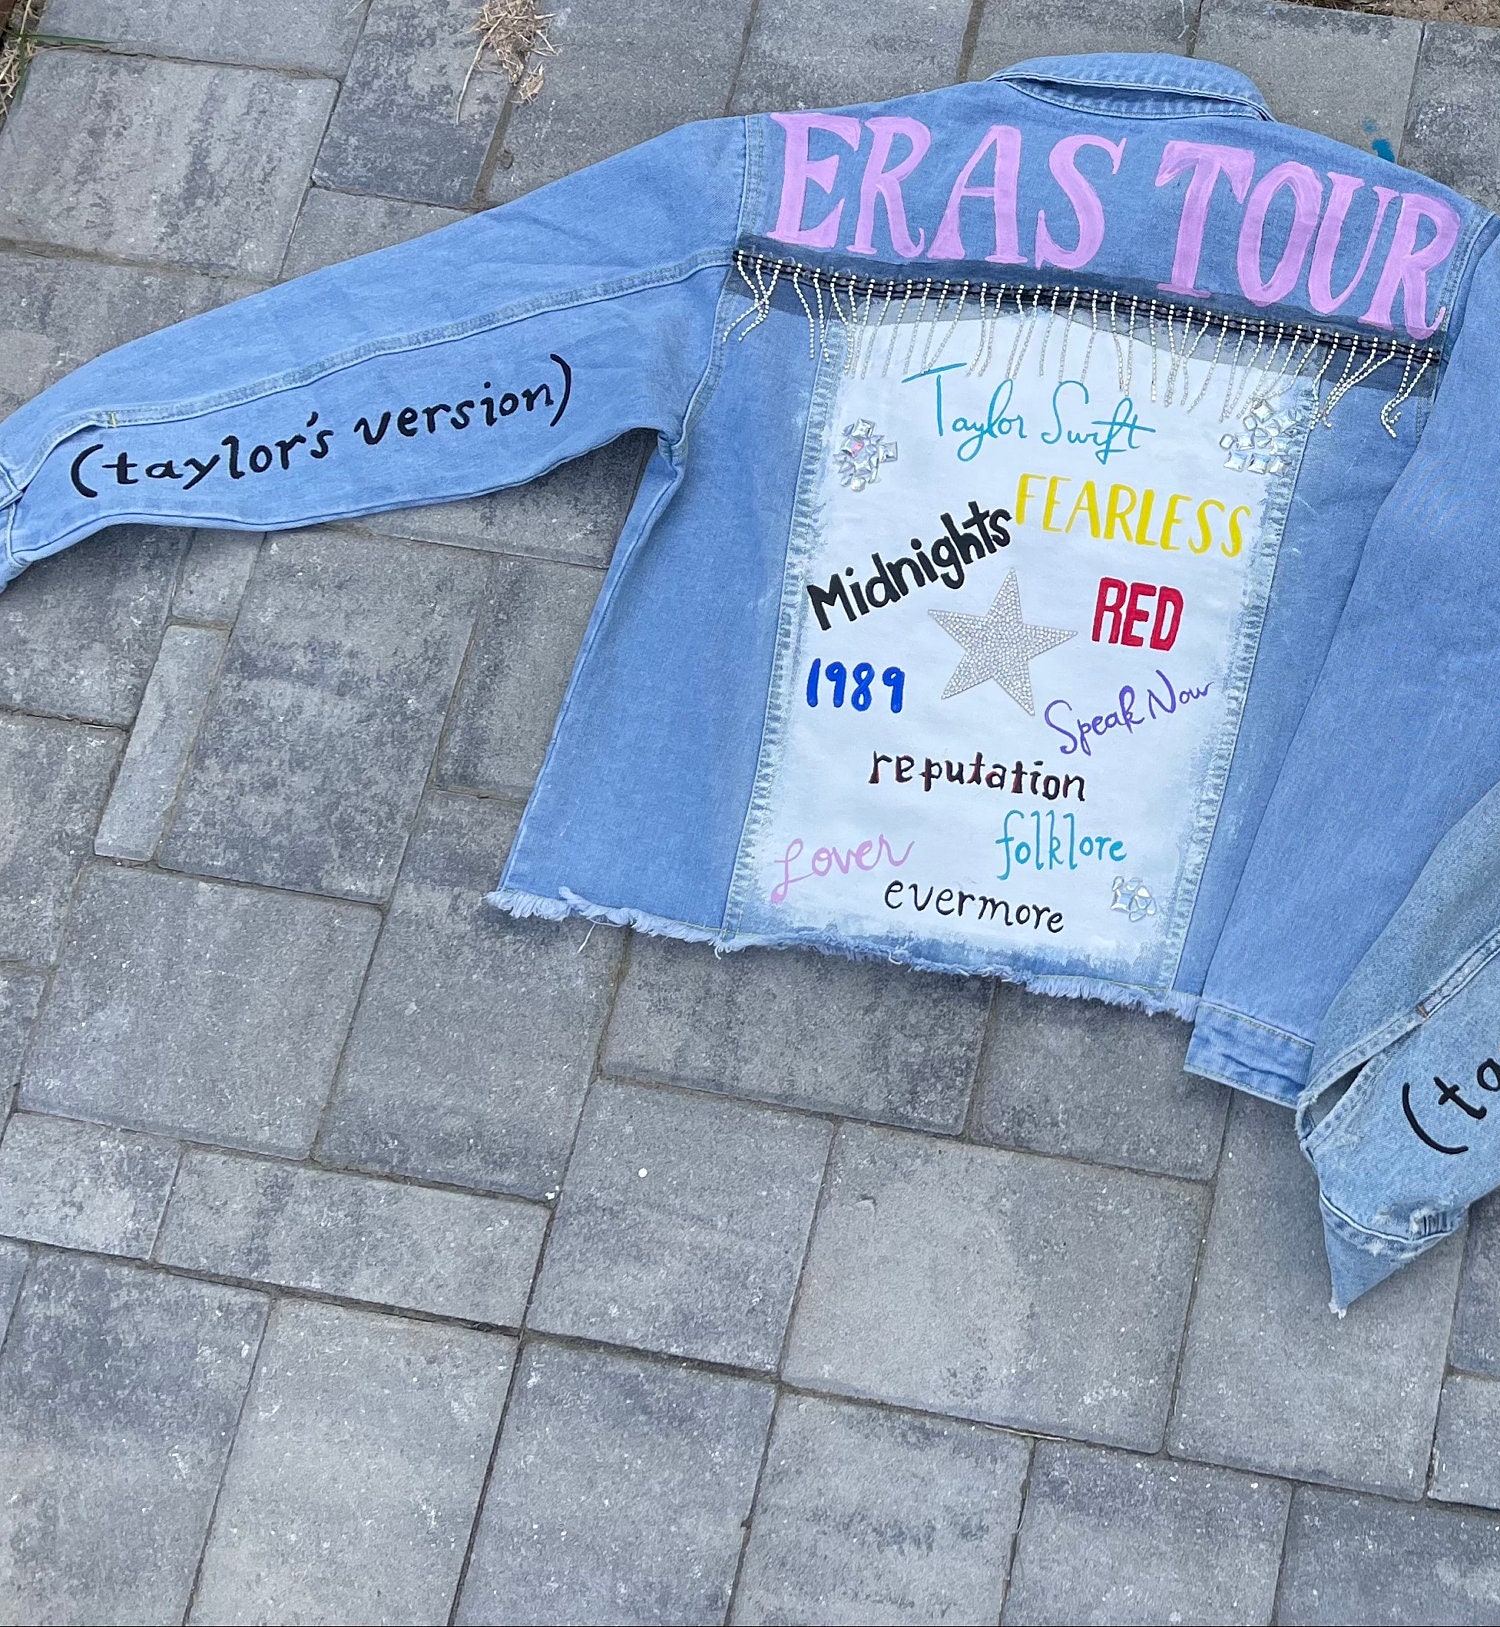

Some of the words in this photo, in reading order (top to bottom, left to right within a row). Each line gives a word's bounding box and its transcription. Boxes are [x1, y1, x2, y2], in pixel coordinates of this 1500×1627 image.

[764, 111, 1127, 270] ERAS
[1153, 139, 1461, 339] TOUR
[70, 410, 334, 498] (taylor's
[353, 353, 572, 447] version)
[902, 362, 1028, 462] Taylor
[1040, 380, 1155, 464] Swift
[1014, 472, 1252, 558] FEARLESS
[806, 500, 1013, 631] Midnights
[1091, 576, 1185, 652] RED
[805, 657, 906, 714] 1989
[1043, 684, 1144, 756] Speak
[1147, 669, 1216, 720] Now
[867, 749, 1086, 802] reputation
[770, 832, 915, 904] Lover
[995, 809, 1128, 881] folklore
[884, 879, 1065, 934] evermore
